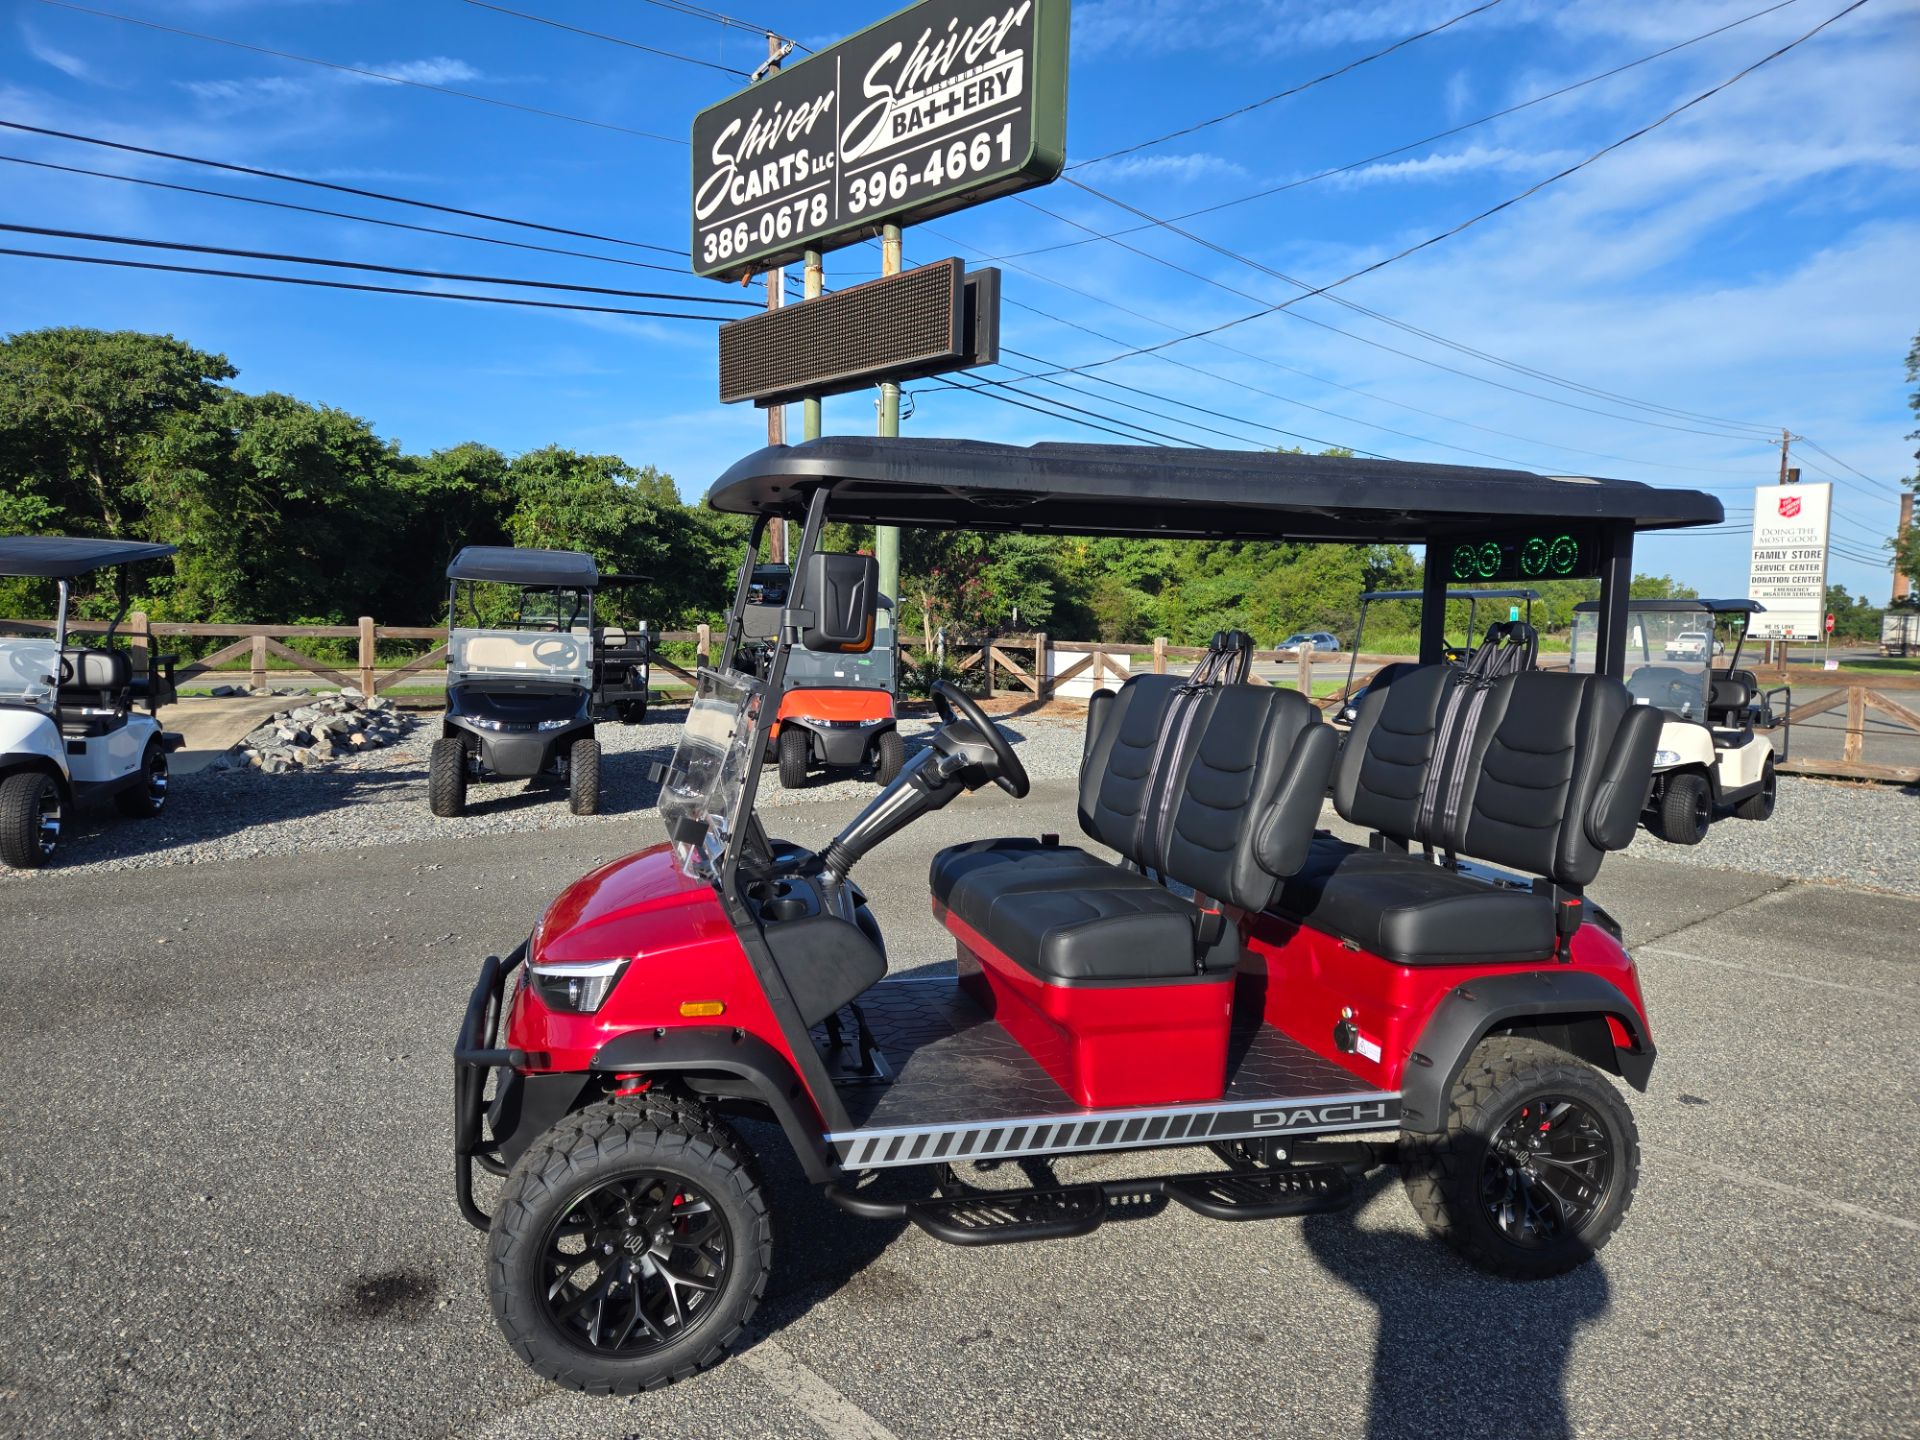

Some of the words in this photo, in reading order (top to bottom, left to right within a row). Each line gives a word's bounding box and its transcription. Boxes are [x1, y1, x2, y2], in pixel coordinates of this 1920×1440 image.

[840, 0, 1031, 163] Shiver
[695, 90, 835, 221] Shiver
[849, 122, 1012, 214] 396-4661
[730, 149, 809, 206] CARTS
[812, 151, 835, 175] LLC
[703, 192, 828, 264] 386-0678
[1760, 536, 1785, 544] MOST
[1787, 535, 1817, 543] GOOD
[1762, 528, 1795, 536] DOING
[1797, 527, 1815, 535] THE
[1754, 551, 1788, 560] FAMILY
[1791, 550, 1822, 559] STORE
[1755, 564, 1786, 572] SERVICE
[1789, 563, 1820, 571] CENTER
[1752, 576, 1790, 584] DONATION
[1253, 1103, 1385, 1128] DACH
